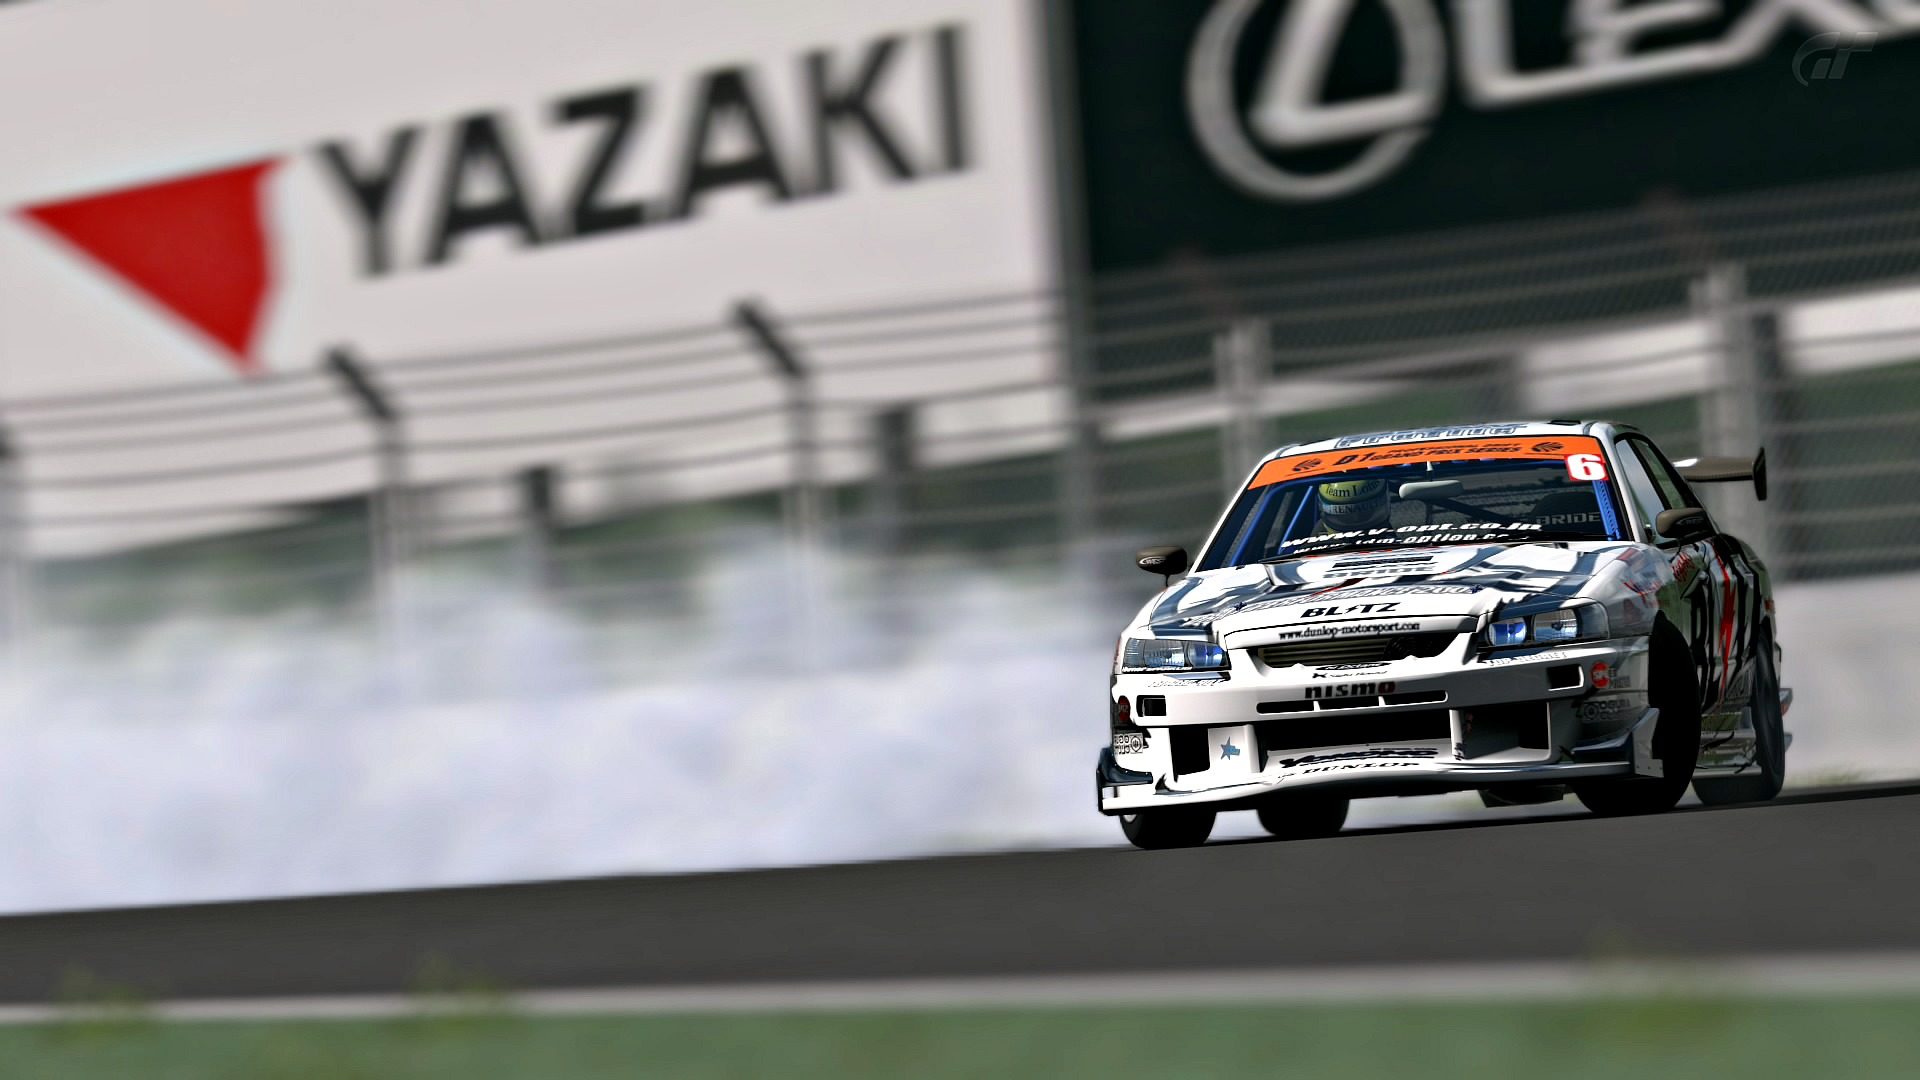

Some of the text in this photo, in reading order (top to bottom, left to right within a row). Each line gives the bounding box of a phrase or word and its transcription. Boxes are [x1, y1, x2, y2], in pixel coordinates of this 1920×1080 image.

[308, 22, 974, 278] YAZAKI
[1567, 454, 1606, 480] 6
[1300, 602, 1401, 618] BLITZ
[1279, 622, 1421, 640] www.dunlop-motorsport.com
[1304, 681, 1396, 699] nismo
